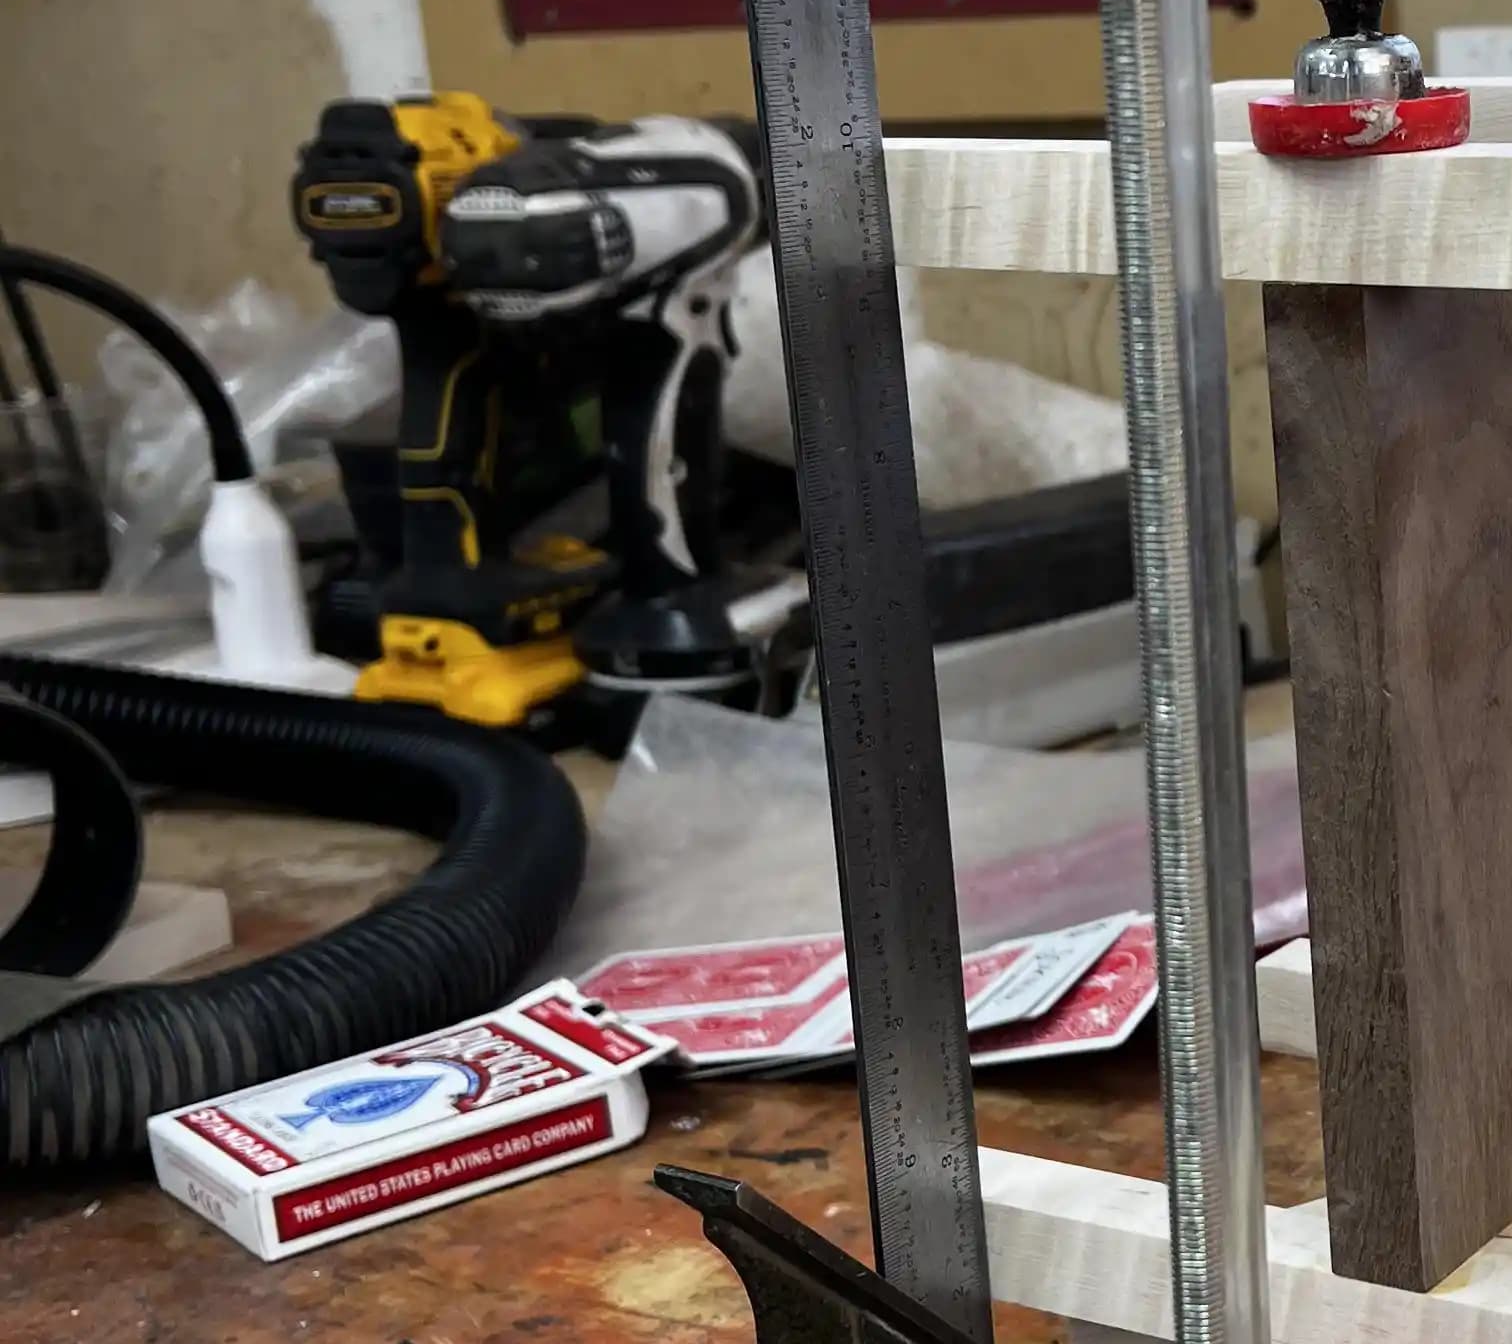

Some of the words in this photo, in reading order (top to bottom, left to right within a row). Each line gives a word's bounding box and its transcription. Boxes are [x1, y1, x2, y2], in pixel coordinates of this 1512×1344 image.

[801, 125, 814, 140] 2
[839, 122, 854, 152] 10
[400, 1025, 572, 1108] BICYCLE
[188, 1108, 288, 1173] STANDARD
[292, 1199, 324, 1223] THE
[325, 1183, 379, 1213] UNITED
[379, 1166, 432, 1197] STATES
[433, 1147, 492, 1178] PLAYING
[493, 1132, 532, 1159] CARD
[532, 1114, 595, 1148] COMPANY
[904, 1154, 916, 1168] 9
[941, 1153, 952, 1168] 3
